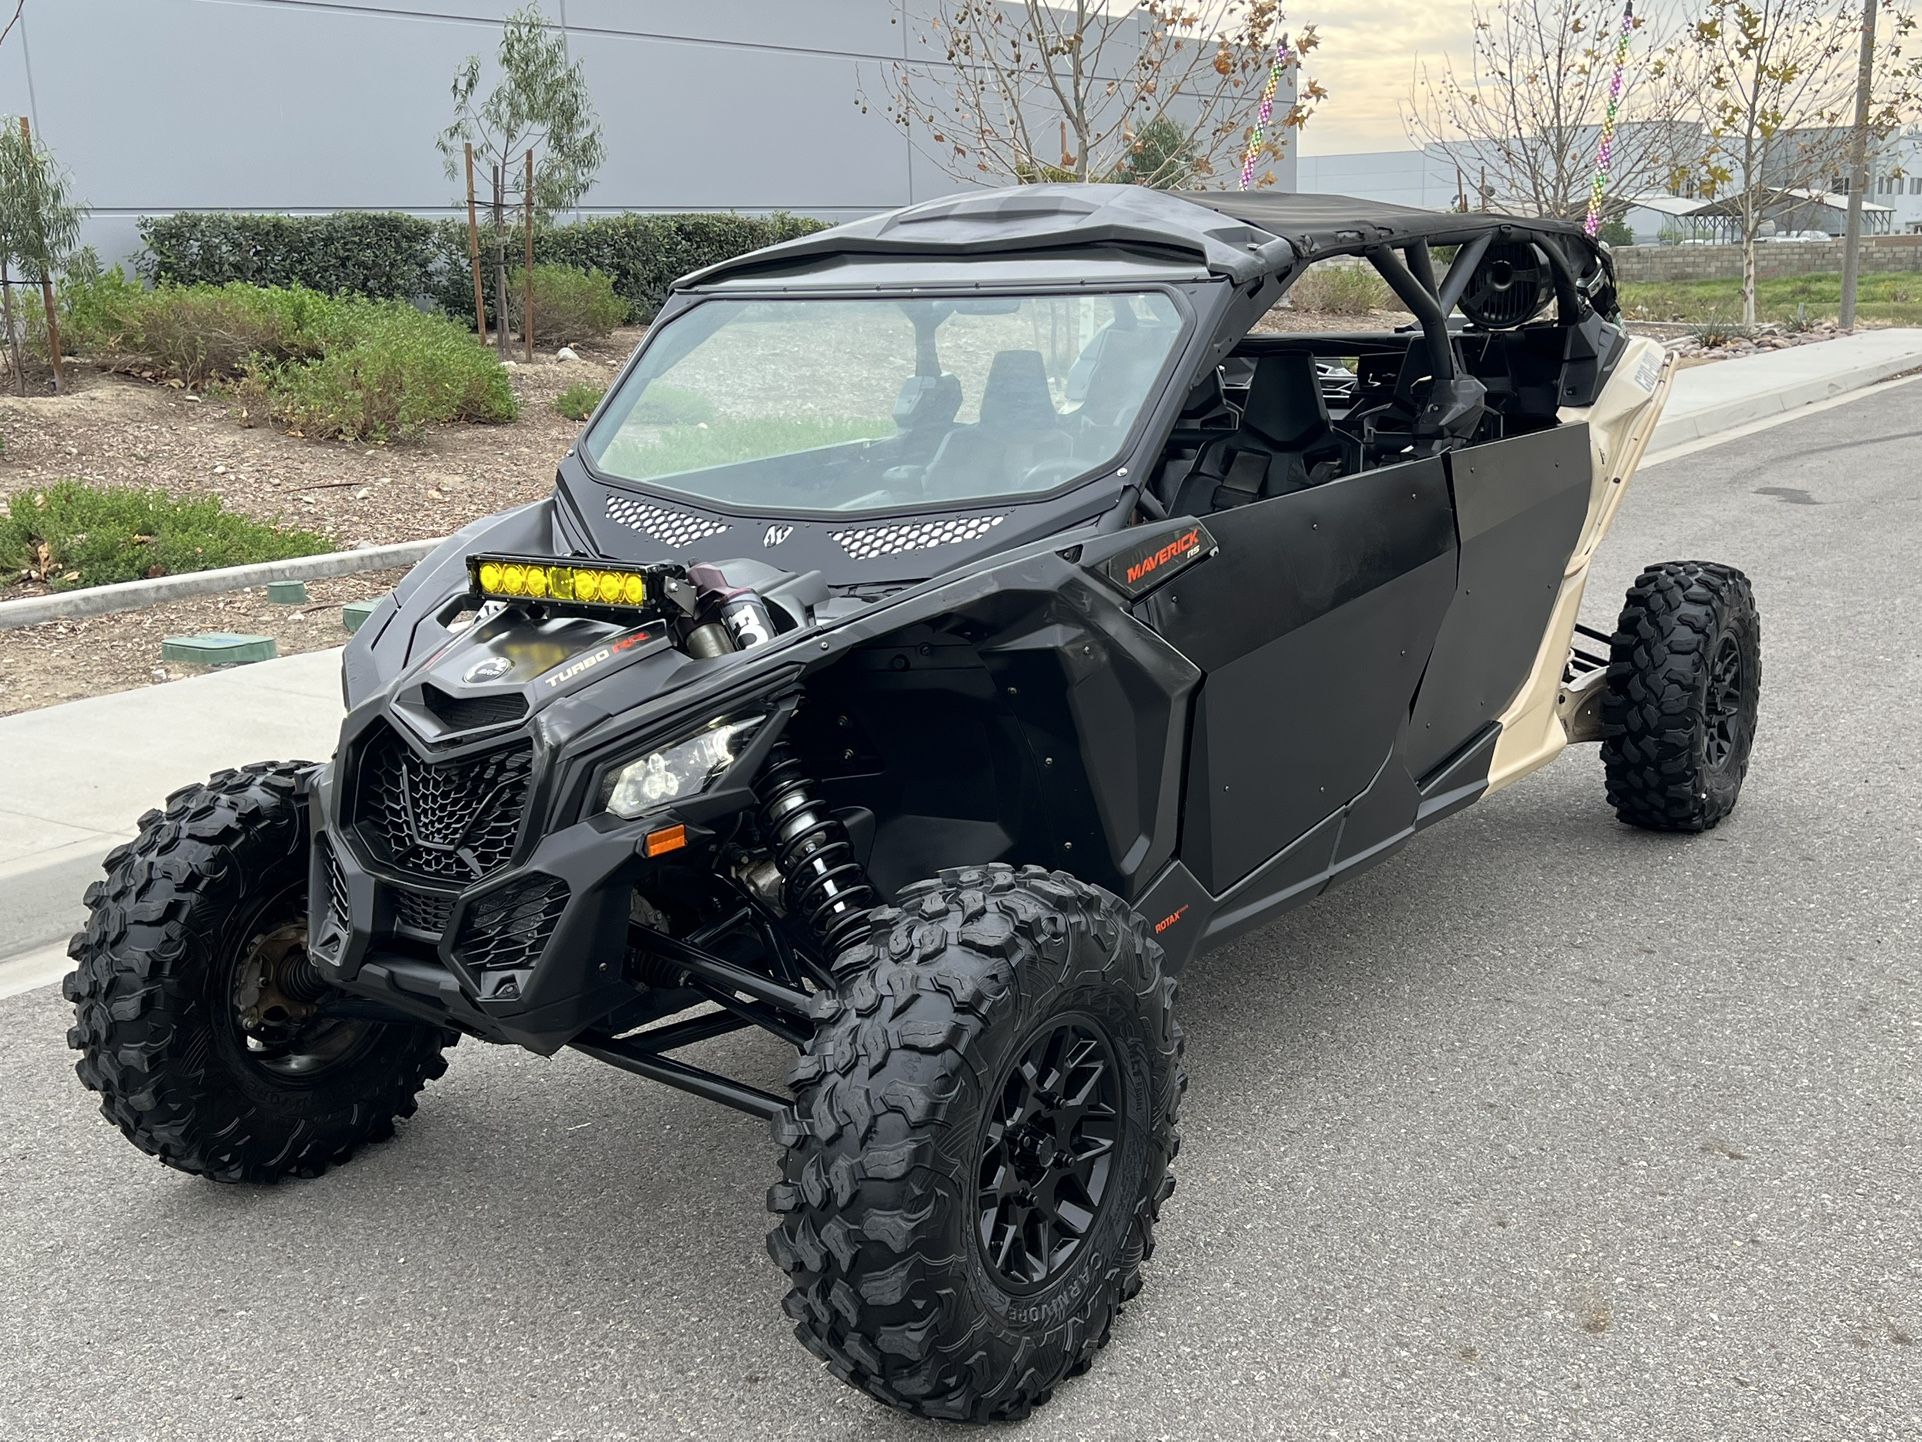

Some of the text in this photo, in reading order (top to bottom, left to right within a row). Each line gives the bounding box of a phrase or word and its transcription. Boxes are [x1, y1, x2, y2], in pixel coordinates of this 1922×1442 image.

[1126, 528, 1200, 583] MAVERICK
[728, 605, 768, 650] FO
[545, 648, 609, 688] TURBO
[1155, 910, 1180, 935] ROTAX
[1008, 1251, 1103, 1322] CARNIVORE
